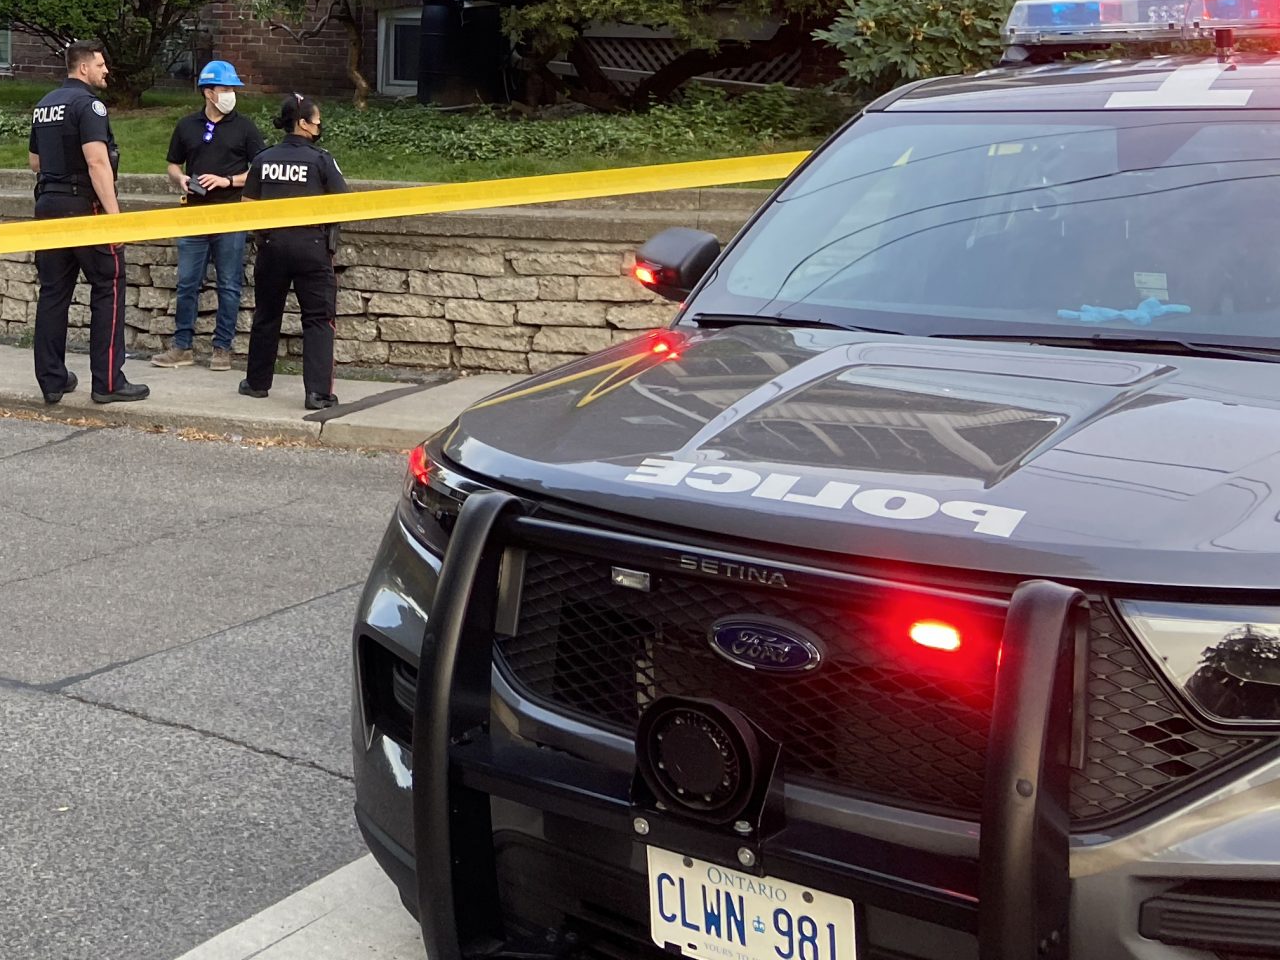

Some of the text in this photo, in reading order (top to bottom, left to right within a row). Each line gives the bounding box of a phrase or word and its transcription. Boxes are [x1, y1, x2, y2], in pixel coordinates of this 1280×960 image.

[32, 104, 66, 124] POLICE
[261, 163, 309, 183] POLICE
[678, 554, 790, 589] SETINA
[731, 630, 794, 664] Ford
[707, 867, 788, 903] ONTARIO
[657, 872, 837, 960] CLWN 981
